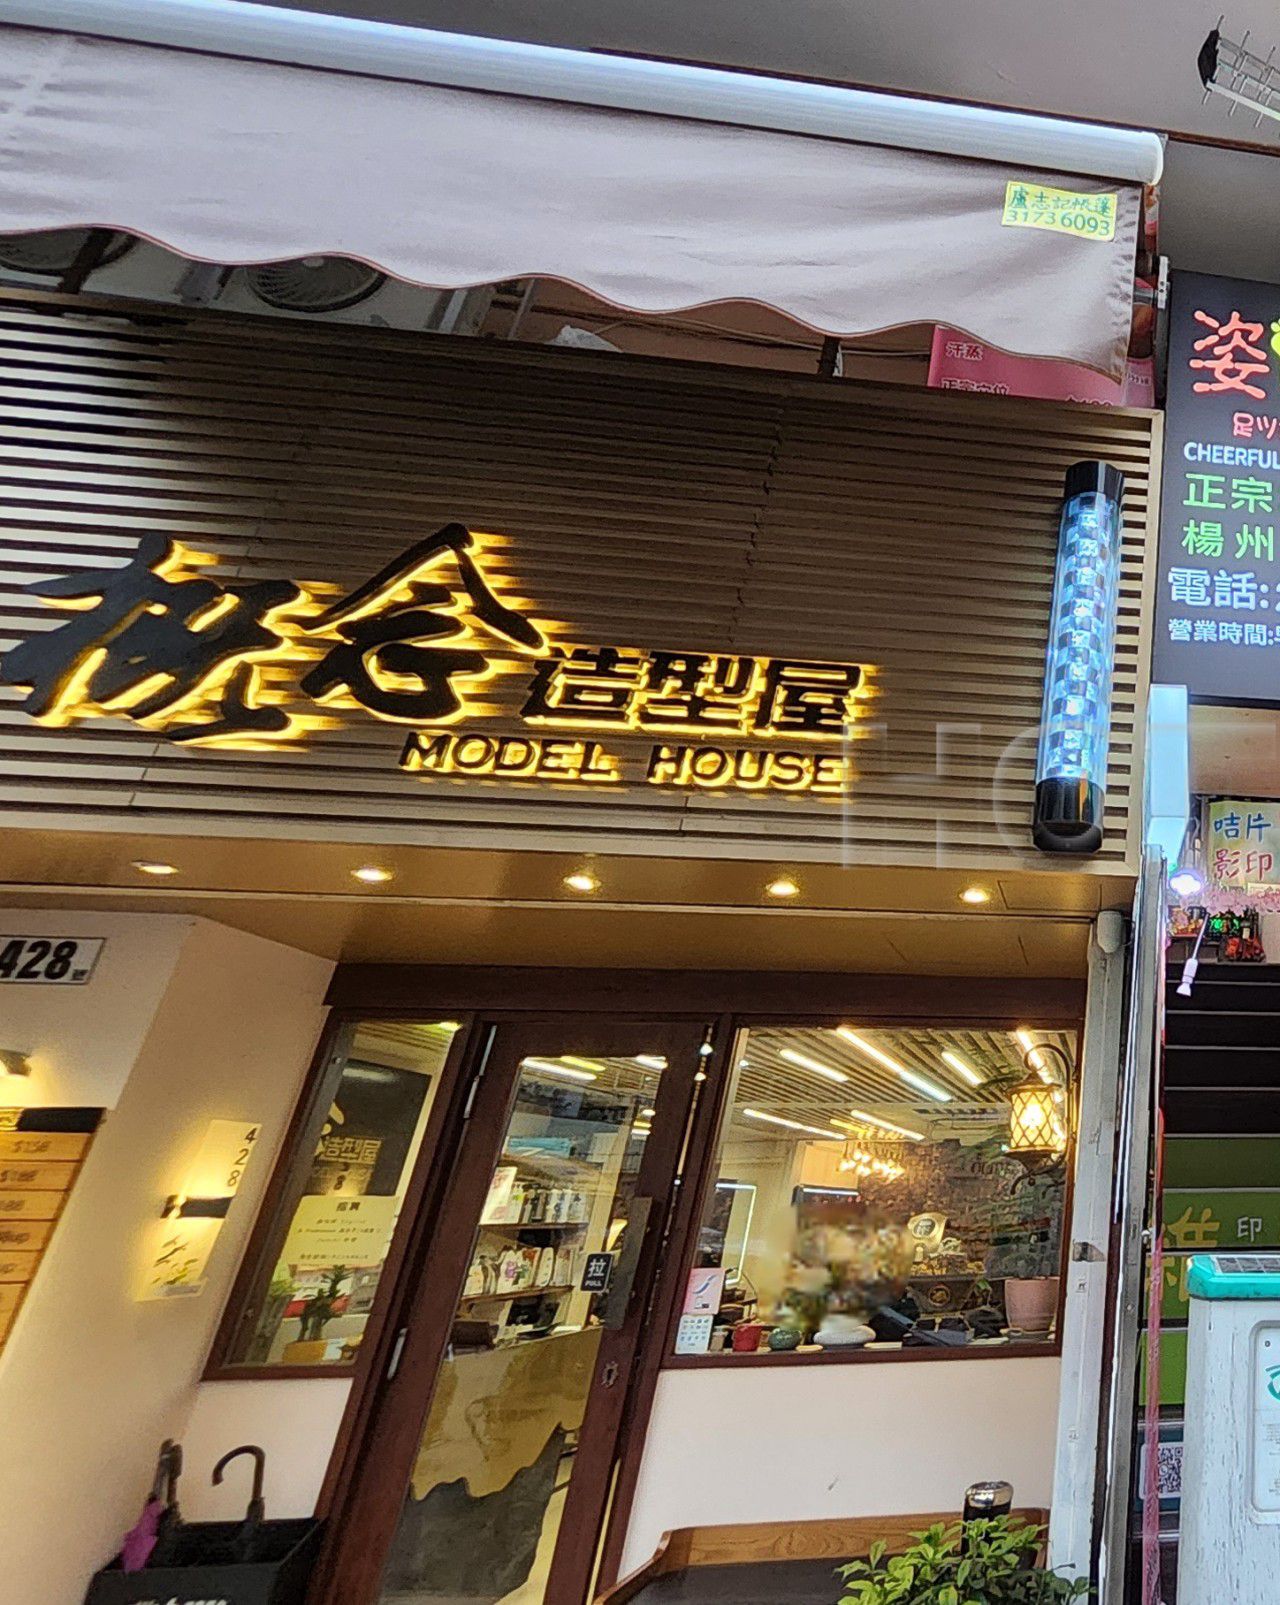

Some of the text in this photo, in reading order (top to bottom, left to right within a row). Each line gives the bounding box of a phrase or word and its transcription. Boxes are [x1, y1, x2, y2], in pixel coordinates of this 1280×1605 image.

[1005, 208, 1110, 236] 31736093
[520, 646, 863, 736] 造型屋
[399, 731, 849, 791] MODEL HOUSE
[1213, 810, 1271, 843] 咭片
[1212, 848, 1273, 881] 影印
[0, 940, 78, 980] 428
[587, 1258, 607, 1278] 拉
